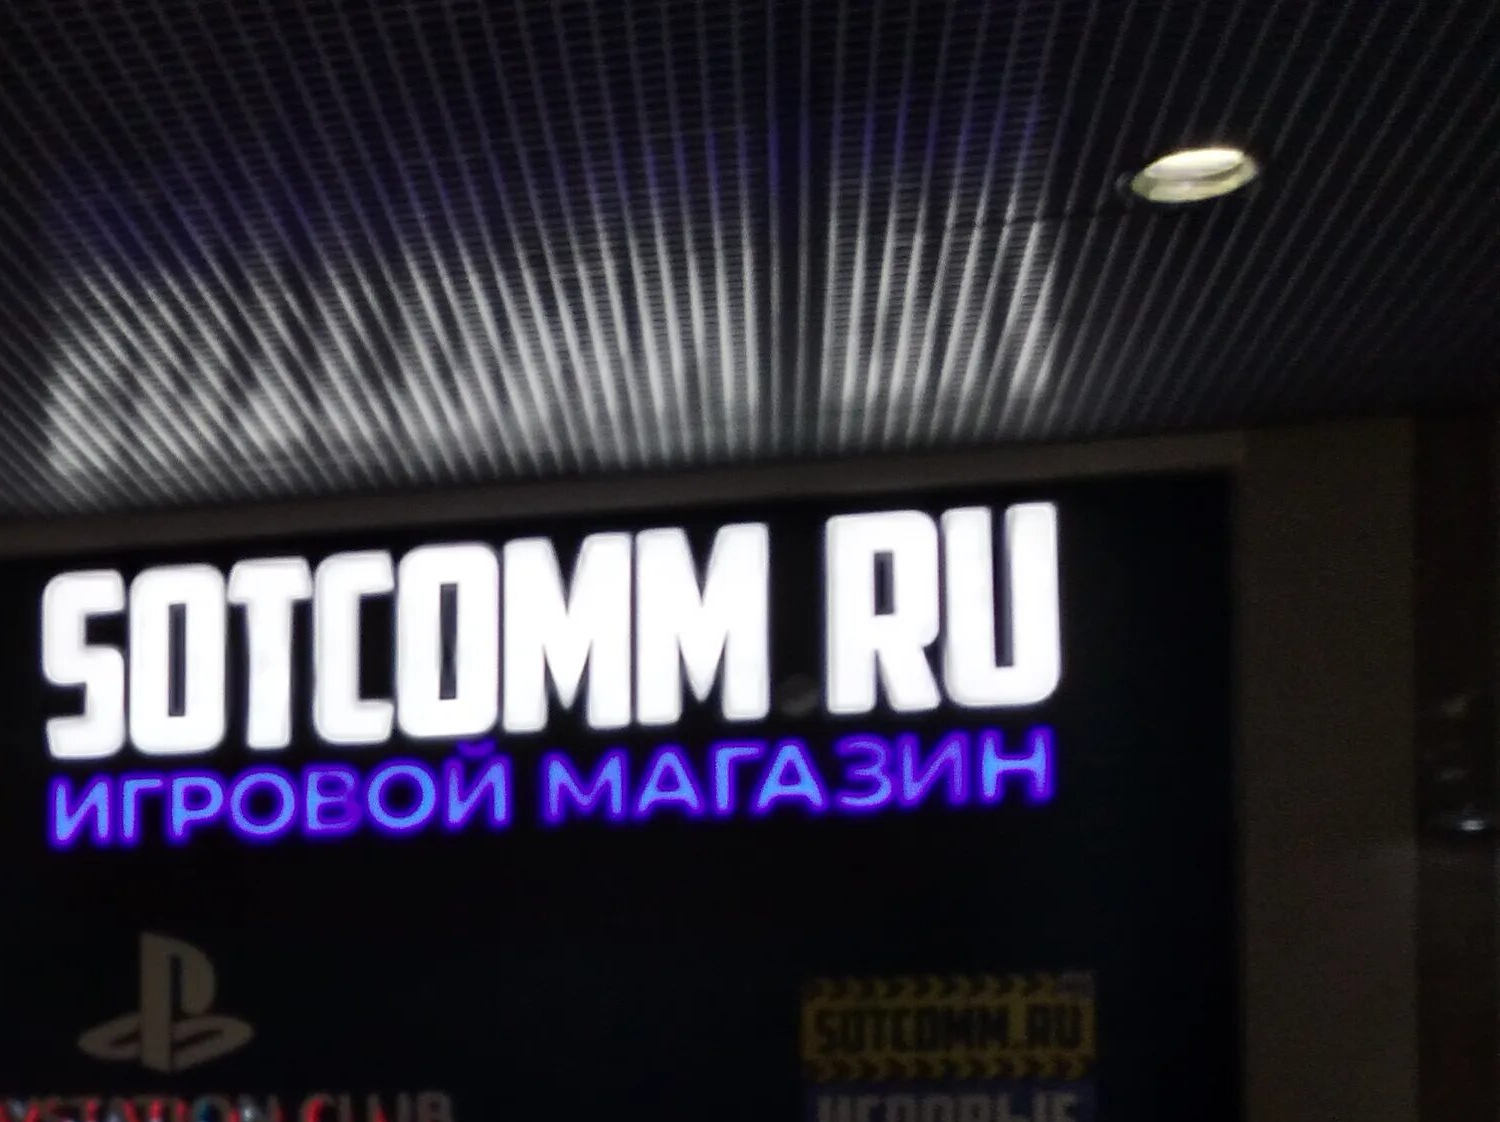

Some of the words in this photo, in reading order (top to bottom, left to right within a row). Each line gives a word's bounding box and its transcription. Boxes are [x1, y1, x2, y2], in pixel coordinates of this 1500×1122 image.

[42, 502, 1062, 759] SOTCOMM.RU
[47, 740, 514, 848] ИГРОВОЙ
[544, 726, 1058, 822] МАГАЗИН
